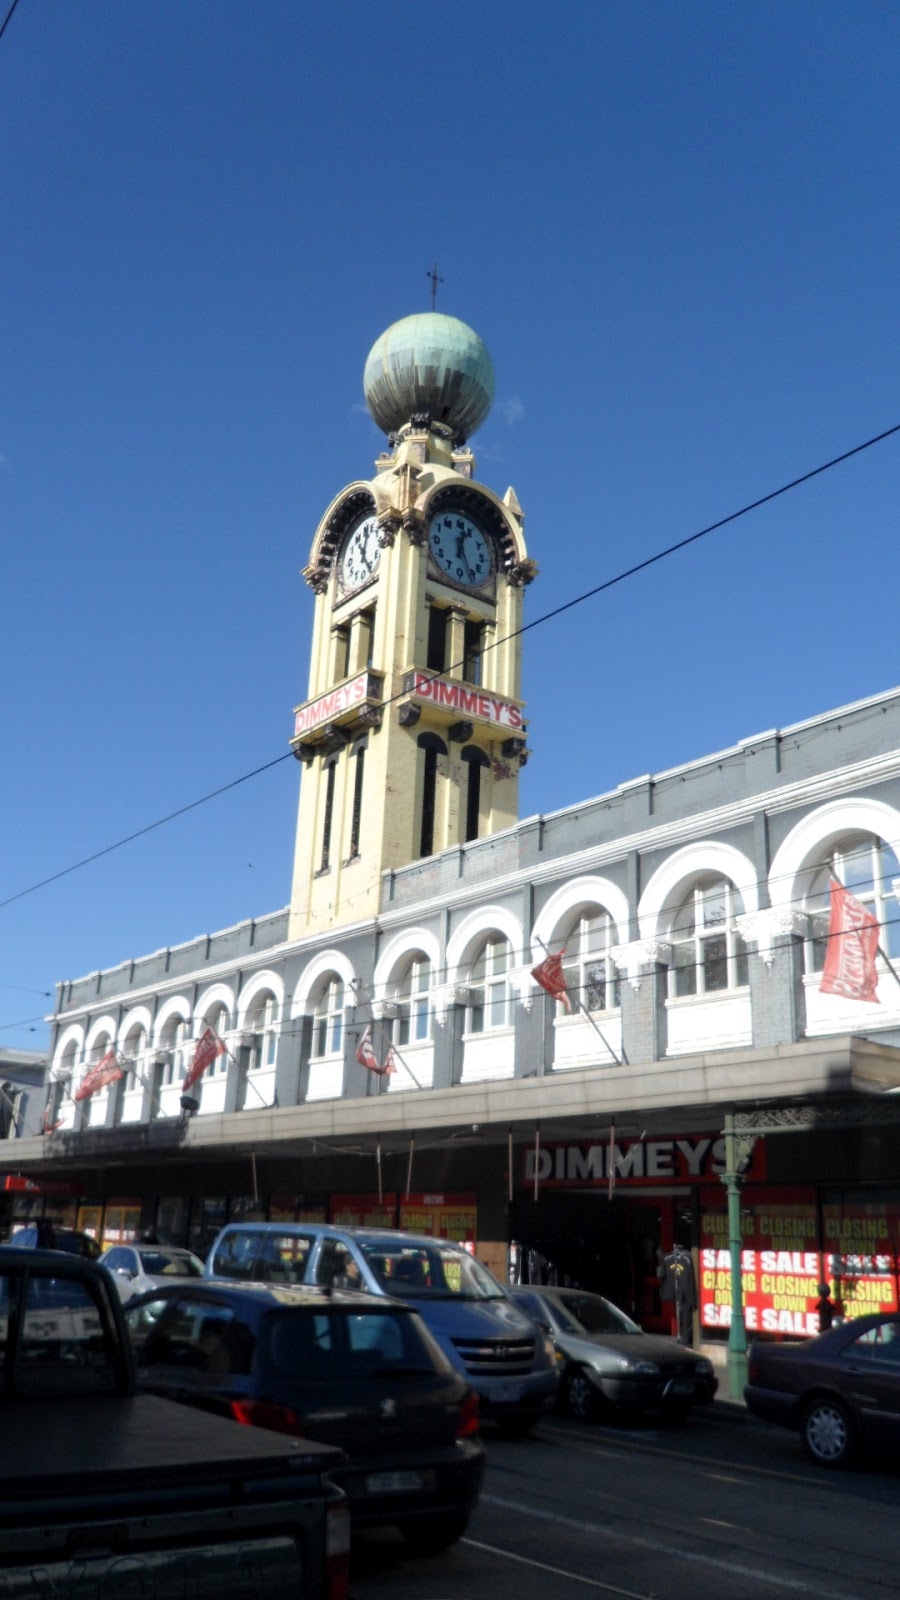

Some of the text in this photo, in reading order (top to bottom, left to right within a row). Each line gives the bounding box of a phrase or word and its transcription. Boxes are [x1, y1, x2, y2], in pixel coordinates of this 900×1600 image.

[295, 677, 367, 734] DIMMEY'S
[415, 674, 521, 727] DIMMEY'S
[760, 1216, 817, 1237] CLOSING
[827, 1218, 888, 1239] CLOSING
[771, 1236, 805, 1251] DOWN
[840, 1238, 876, 1255] DOWN
[702, 1248, 756, 1271] SAE
[760, 1250, 818, 1275] SALE
[761, 1273, 819, 1297] CLOSING
[773, 1294, 807, 1312] DOWN
[704, 1303, 758, 1329] SAE
[762, 1308, 820, 1335] SALE
